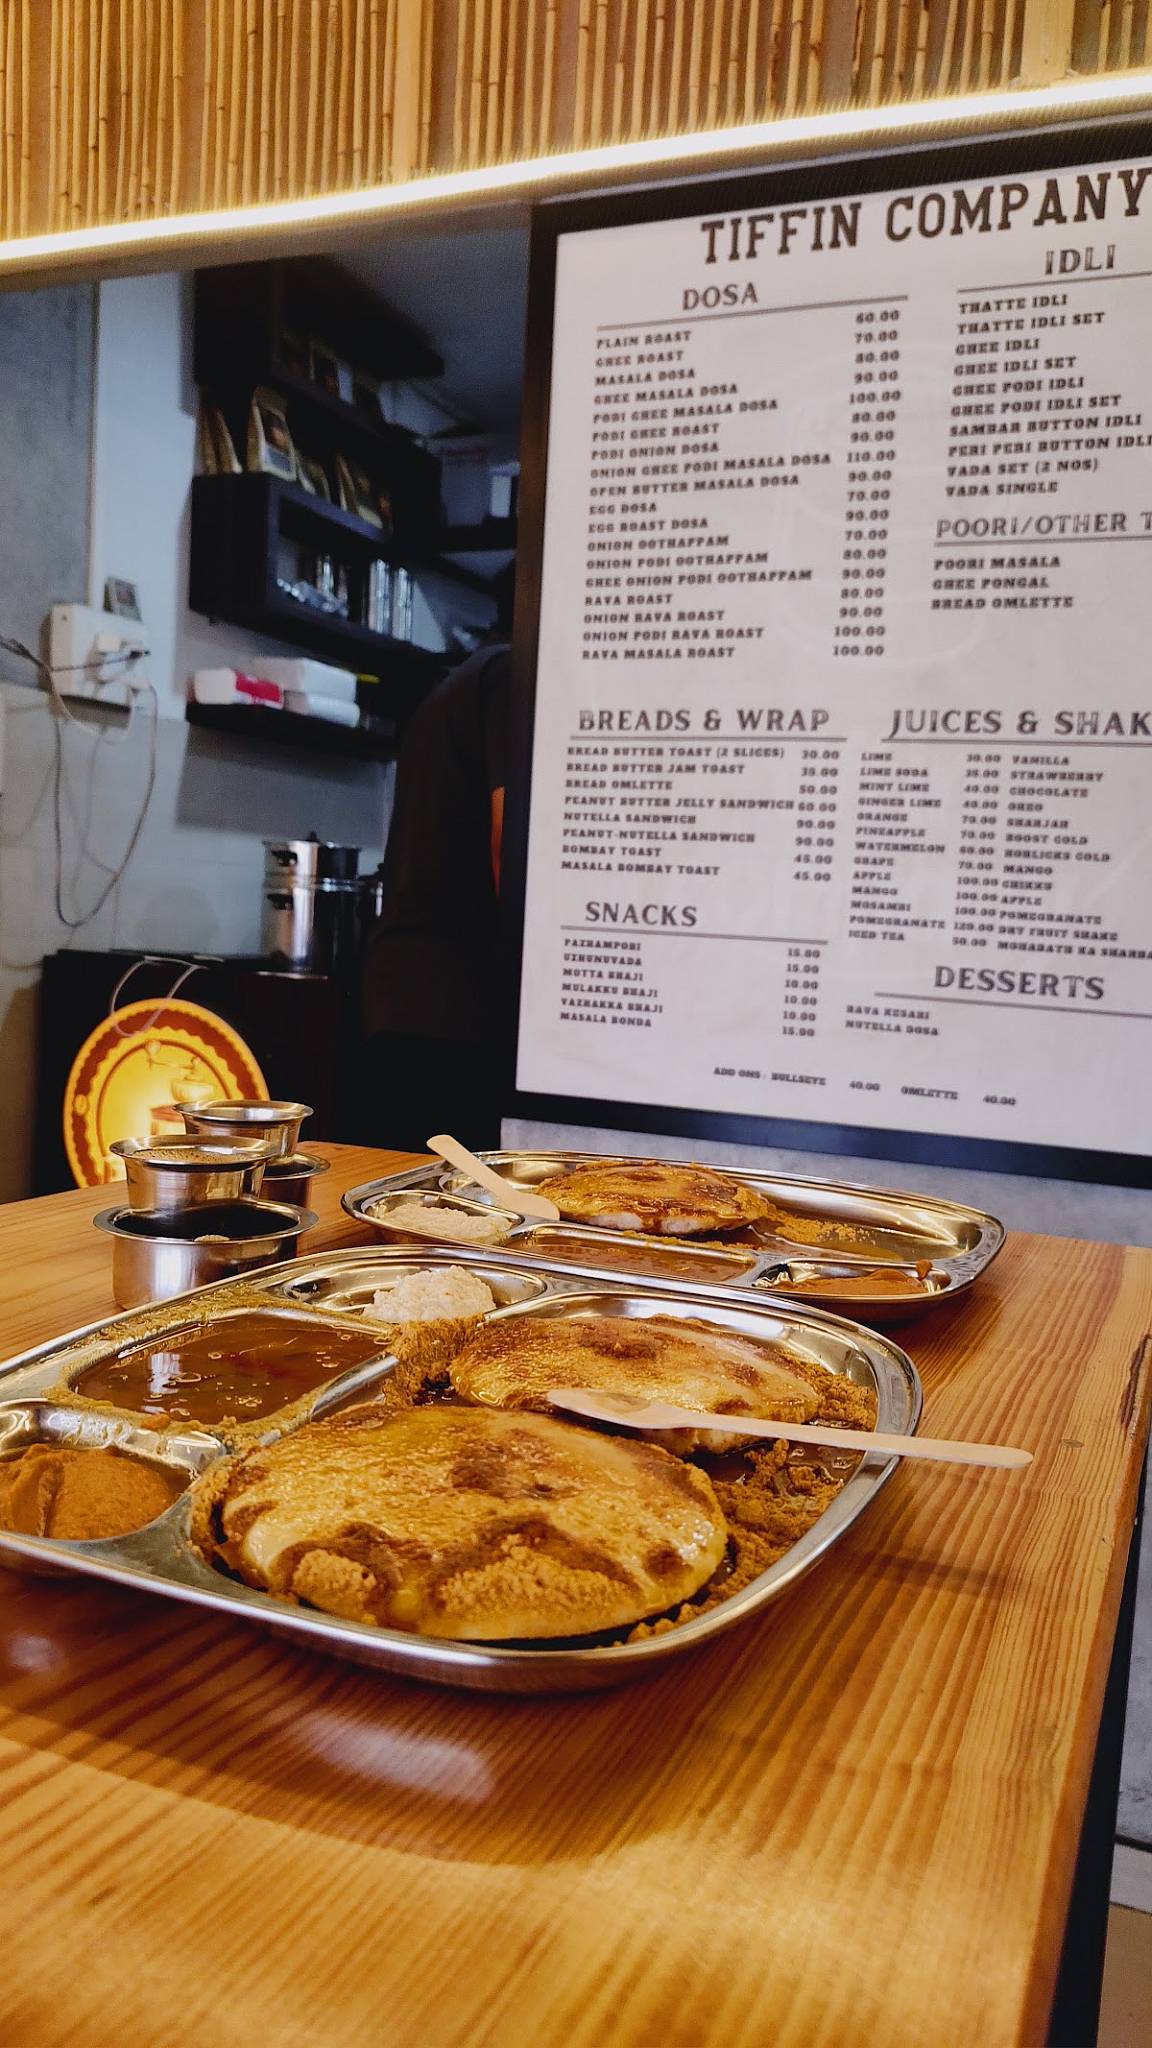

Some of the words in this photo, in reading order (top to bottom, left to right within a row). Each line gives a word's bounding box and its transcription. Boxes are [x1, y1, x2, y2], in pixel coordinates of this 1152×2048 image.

[701, 202, 862, 265] TIFFIN
[886, 167, 1152, 243] COMPANY
[1045, 244, 1115, 275] IDLI
[682, 282, 758, 310] DOSA
[959, 297, 1026, 314] THATTE
[1032, 293, 1067, 308] IDLI
[957, 318, 1024, 335] THATTE
[1031, 315, 1066, 328] IDLI
[1072, 311, 1105, 325] SET
[955, 341, 999, 356] GHEE
[1005, 338, 1039, 351] IDLI
[953, 361, 997, 376] GHEE
[1003, 358, 1038, 373] IDLI
[1044, 356, 1076, 369] SET
[595, 372, 652, 386] MASALA
[658, 368, 695, 381] DOSA
[952, 383, 996, 396] GHEE
[1002, 379, 1042, 393] PODI
[1048, 376, 1084, 390] IDLI
[594, 392, 629, 404] GHEE
[635, 387, 693, 401] MASALA
[700, 383, 737, 396] DOSA
[593, 412, 625, 424] PODI
[630, 408, 667, 421] GHEE
[673, 402, 732, 418] MASALA
[739, 399, 777, 412] DOSA
[950, 402, 994, 417] GHEE
[1000, 399, 1040, 414] PODI
[1047, 397, 1082, 411] IDLI
[1088, 394, 1121, 408] SET
[592, 430, 625, 442] PODI
[630, 427, 667, 439] GHEE
[671, 422, 719, 436] ROAST
[949, 421, 1020, 437] SAMBAR
[1027, 416, 1099, 432] BUTTON
[1105, 414, 1141, 427] IDLI
[948, 443, 986, 457] PERI
[992, 441, 1031, 455] PERI
[1037, 437, 1109, 452] BUTTON
[1116, 434, 1152, 448] IDLI
[590, 466, 636, 478] ONION
[641, 463, 678, 475] GHEE
[683, 460, 718, 473] PODI
[723, 456, 785, 470] MASALA
[791, 453, 831, 466] DOSA
[947, 464, 991, 477] VADA
[997, 462, 1029, 475] SET
[589, 485, 626, 496] OPEN
[632, 481, 688, 495] BUTTER
[693, 477, 754, 491] MASALA
[760, 474, 799, 487] DOSA
[945, 484, 990, 497] VADA
[996, 481, 1058, 495] SINGLE
[588, 523, 614, 533] EGG
[619, 520, 666, 532] ROAST
[671, 517, 708, 530] DOSA
[936, 512, 1127, 538] POORI/OTHER
[586, 558, 632, 569] ONION
[637, 556, 670, 568] PODI
[675, 552, 768, 566] OOTHAPPAM
[934, 558, 984, 570] POORI
[990, 555, 1060, 568] MASALA
[585, 576, 621, 587] GHEE
[626, 575, 673, 586] ONION
[678, 573, 712, 585] PODI
[717, 569, 812, 583] OOTHAPPAM
[932, 578, 975, 590] GHEE
[981, 576, 1048, 589] PONGAL
[584, 595, 621, 606] RAVA
[626, 593, 672, 605] ROAST
[931, 597, 986, 609] BREAD
[991, 596, 1073, 608] OMLETTE
[583, 631, 628, 641] ONION
[633, 630, 666, 641] PODI
[671, 628, 710, 640] RAVA
[715, 627, 764, 639] ROAST
[582, 650, 618, 659] RAVA
[623, 648, 681, 659] MASALA
[687, 646, 734, 658] ROAST
[579, 709, 690, 731] BREADS
[703, 709, 721, 731] &
[737, 708, 829, 731] WRAP
[888, 709, 1001, 738] JUICES
[1016, 710, 1038, 734] &
[567, 746, 608, 755] BREAD
[613, 747, 664, 757] BUTTER
[669, 747, 712, 756] TOAST
[566, 762, 607, 772] BREAD
[612, 763, 663, 773] BUTTER
[667, 763, 696, 773] JAM
[701, 764, 744, 774] TOAST
[565, 779, 606, 789] BREAD
[611, 780, 672, 790] OMLETTE
[564, 795, 615, 806] PEANUT
[620, 797, 670, 807] BUTTER
[675, 798, 714, 808] JELLY
[719, 798, 794, 809] SANDWICH
[563, 812, 620, 822] NUTELLA
[625, 813, 696, 824] SANDWICH
[563, 828, 677, 840] PEANUT-NUTELLA
[682, 831, 755, 843] SANDWICH
[562, 844, 615, 854] BOMBAY
[620, 846, 661, 857] TOAST
[561, 860, 612, 871] MASALA
[617, 863, 672, 874] BOMBAY
[677, 865, 720, 875] TOAST
[585, 901, 696, 927] SNACKS
[934, 965, 1104, 1000] DESSERTS
